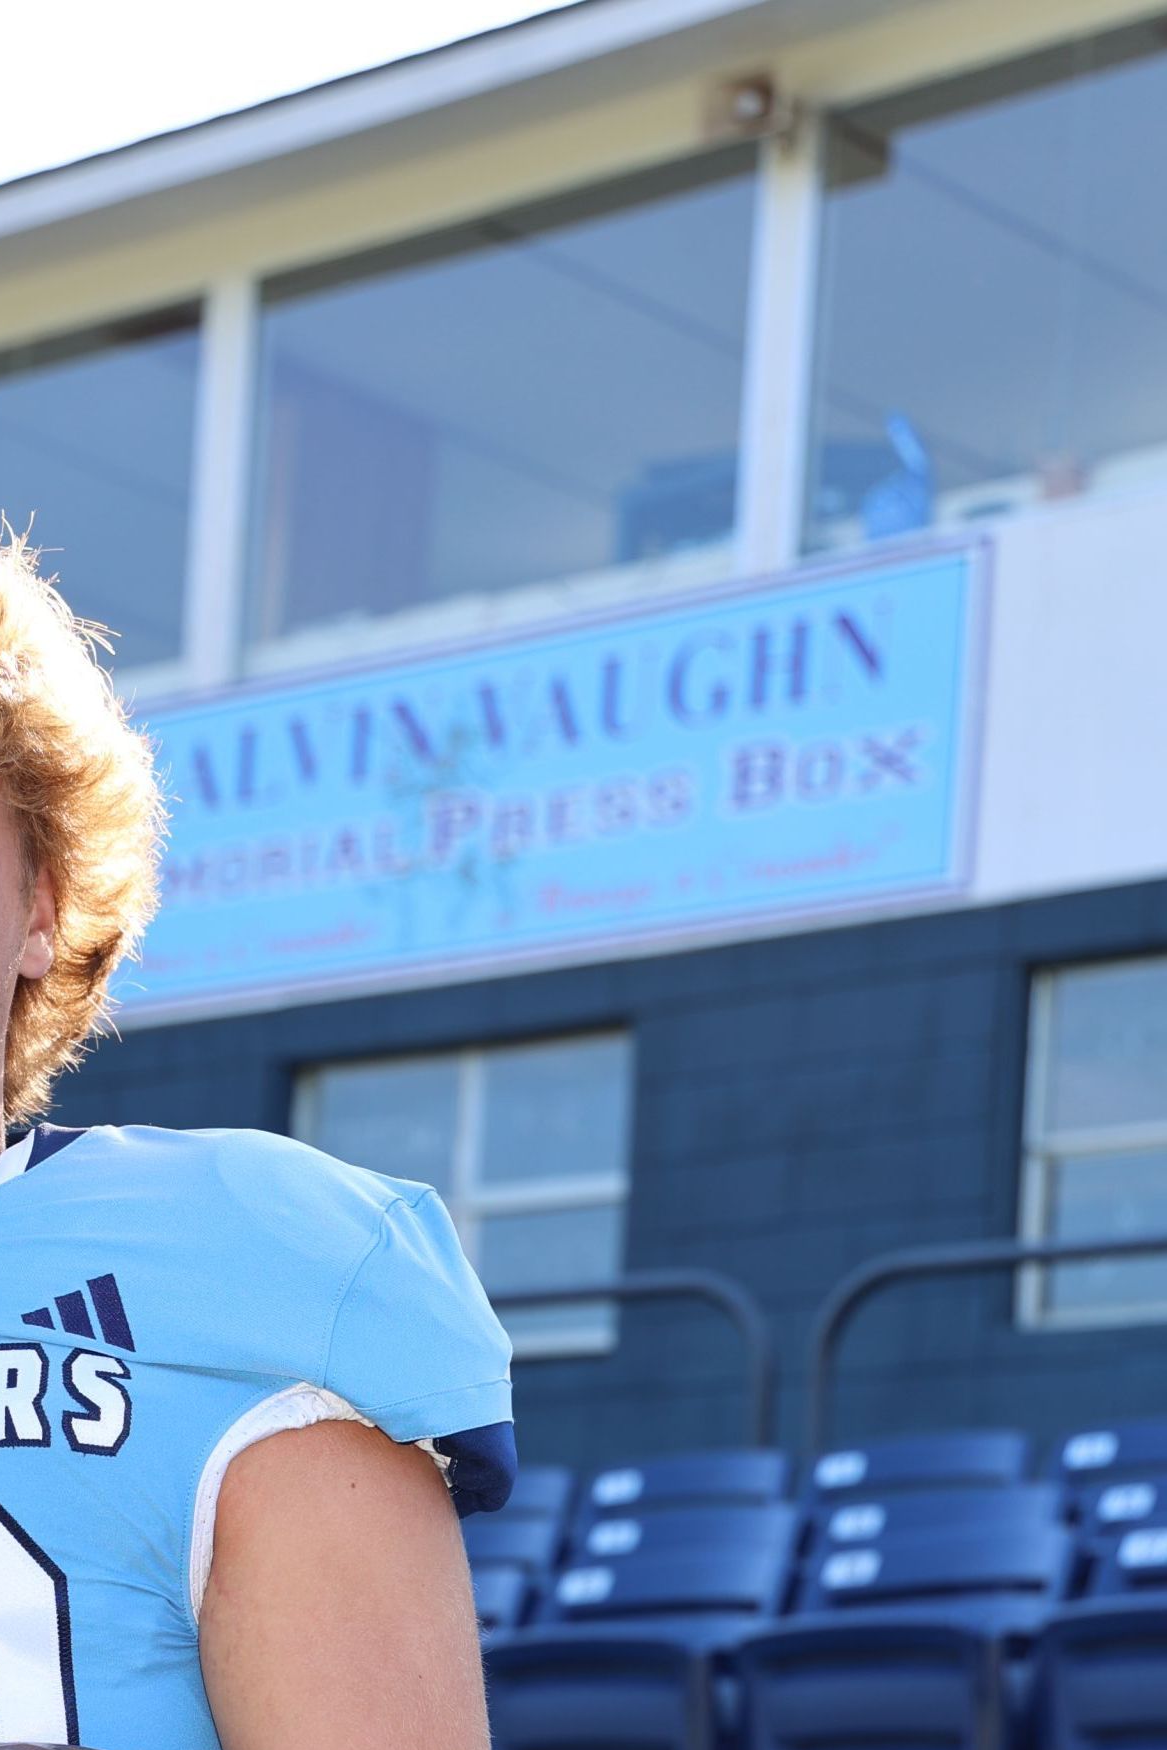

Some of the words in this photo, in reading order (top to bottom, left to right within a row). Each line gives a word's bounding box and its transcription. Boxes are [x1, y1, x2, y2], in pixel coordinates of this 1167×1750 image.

[172, 686, 446, 811] ALVIN
[468, 596, 892, 757] VAUGHN
[428, 771, 694, 864] PRESS
[726, 722, 927, 812] BOX
